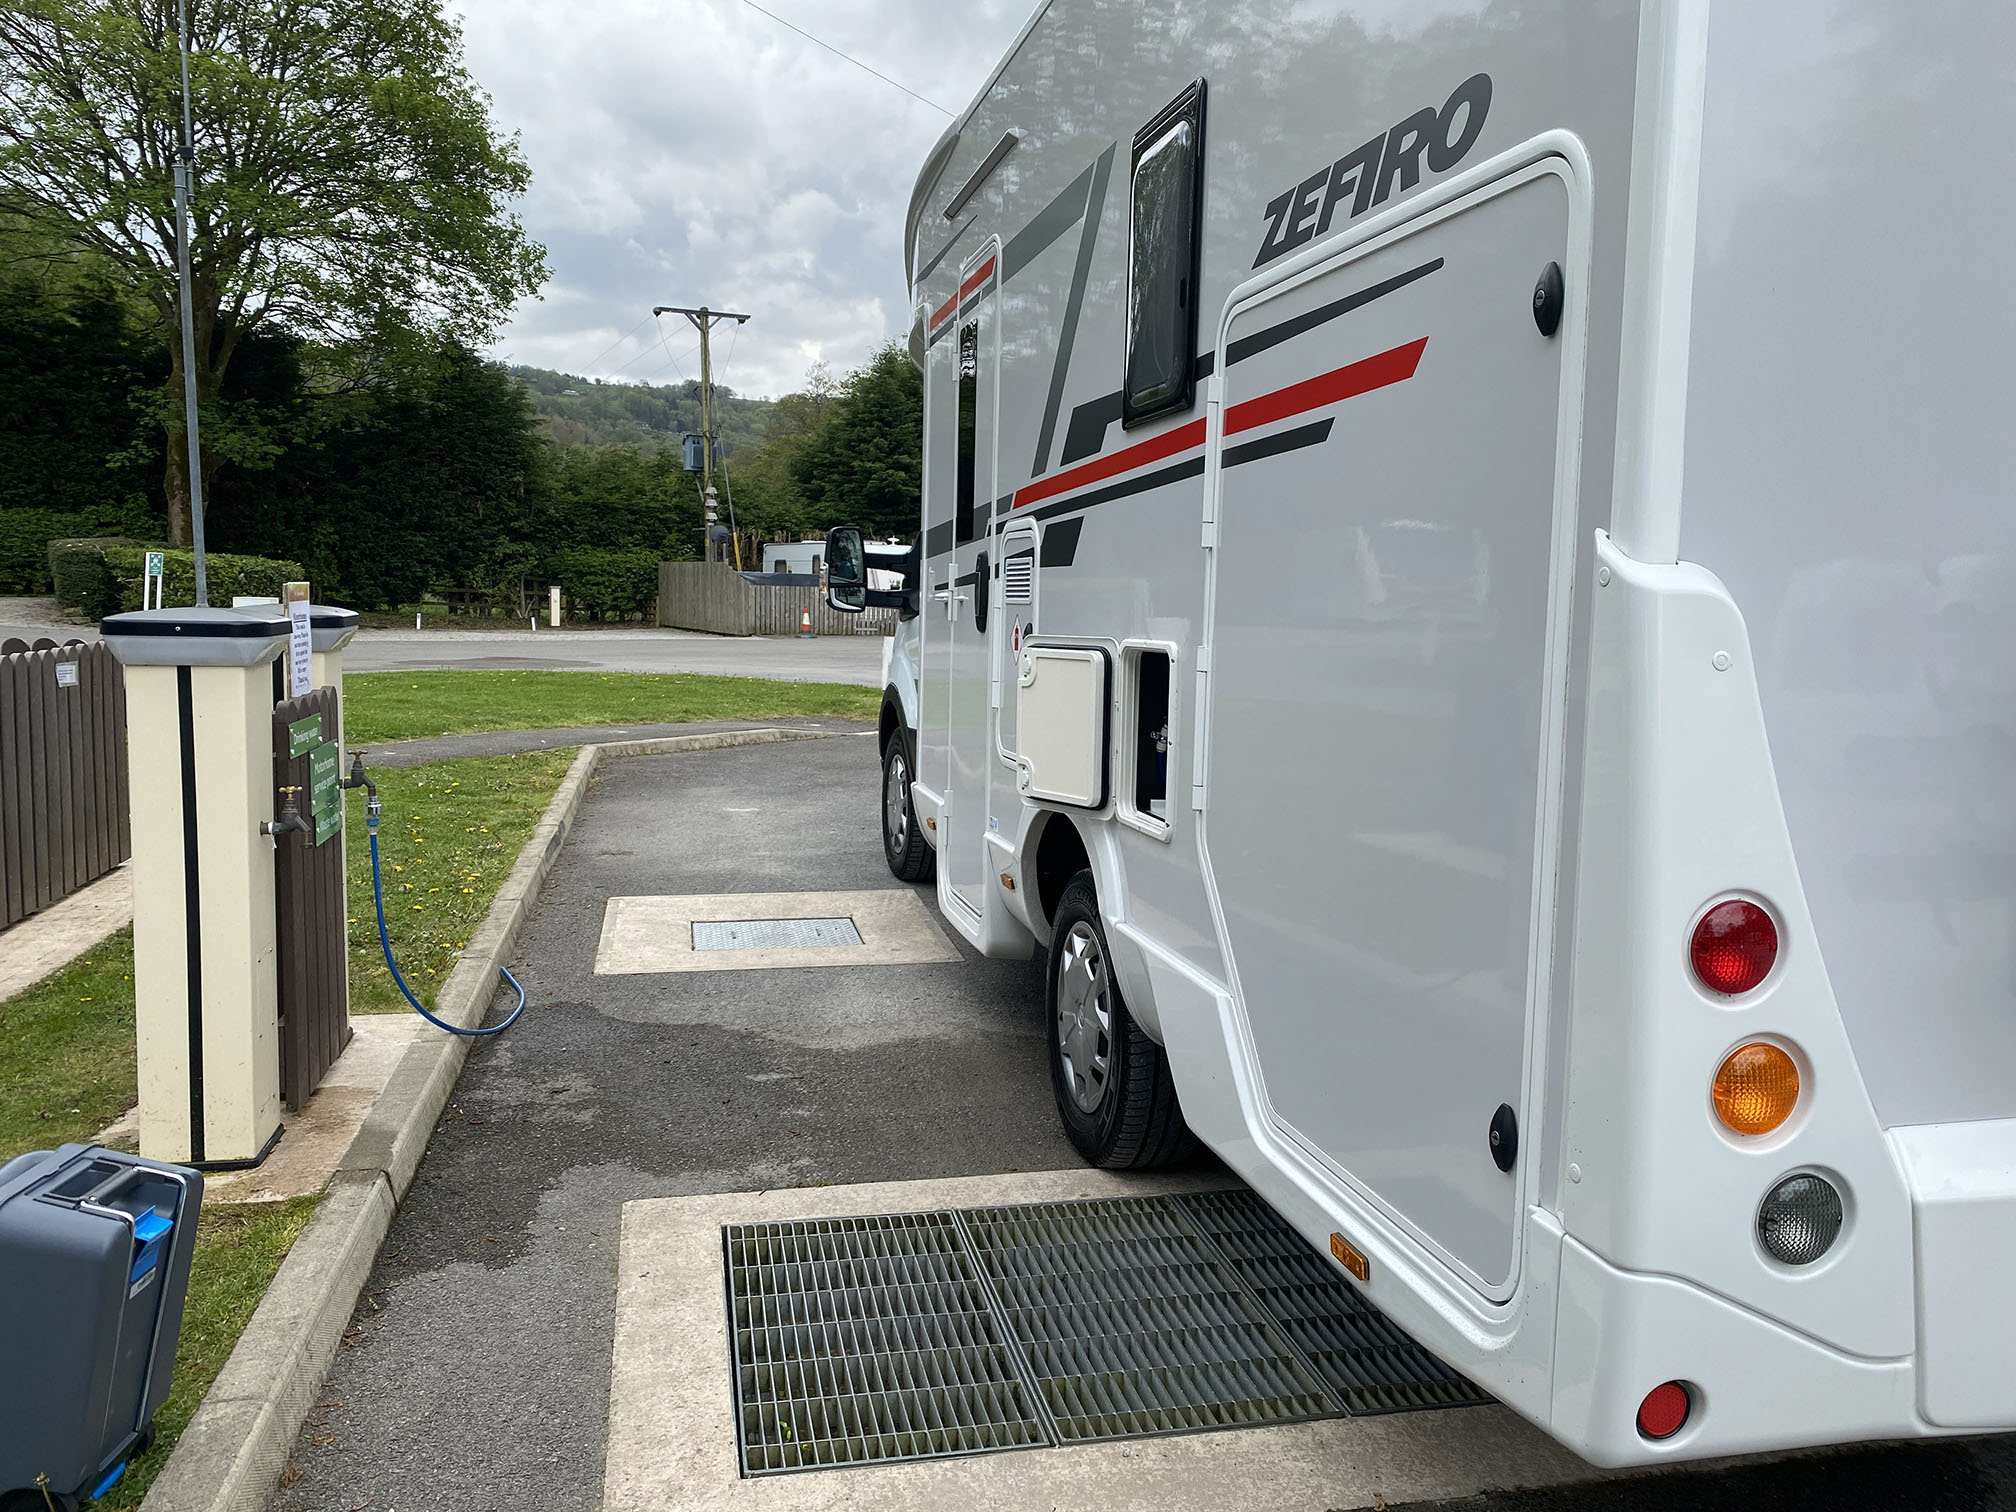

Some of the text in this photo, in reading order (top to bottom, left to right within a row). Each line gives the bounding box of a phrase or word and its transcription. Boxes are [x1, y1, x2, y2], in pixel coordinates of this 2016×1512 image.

[1251, 72, 1493, 270] ZEFIRO
[294, 727, 318, 745] Drinking water
[314, 757, 335, 776] Motorhome
[314, 772, 336, 795] service point
